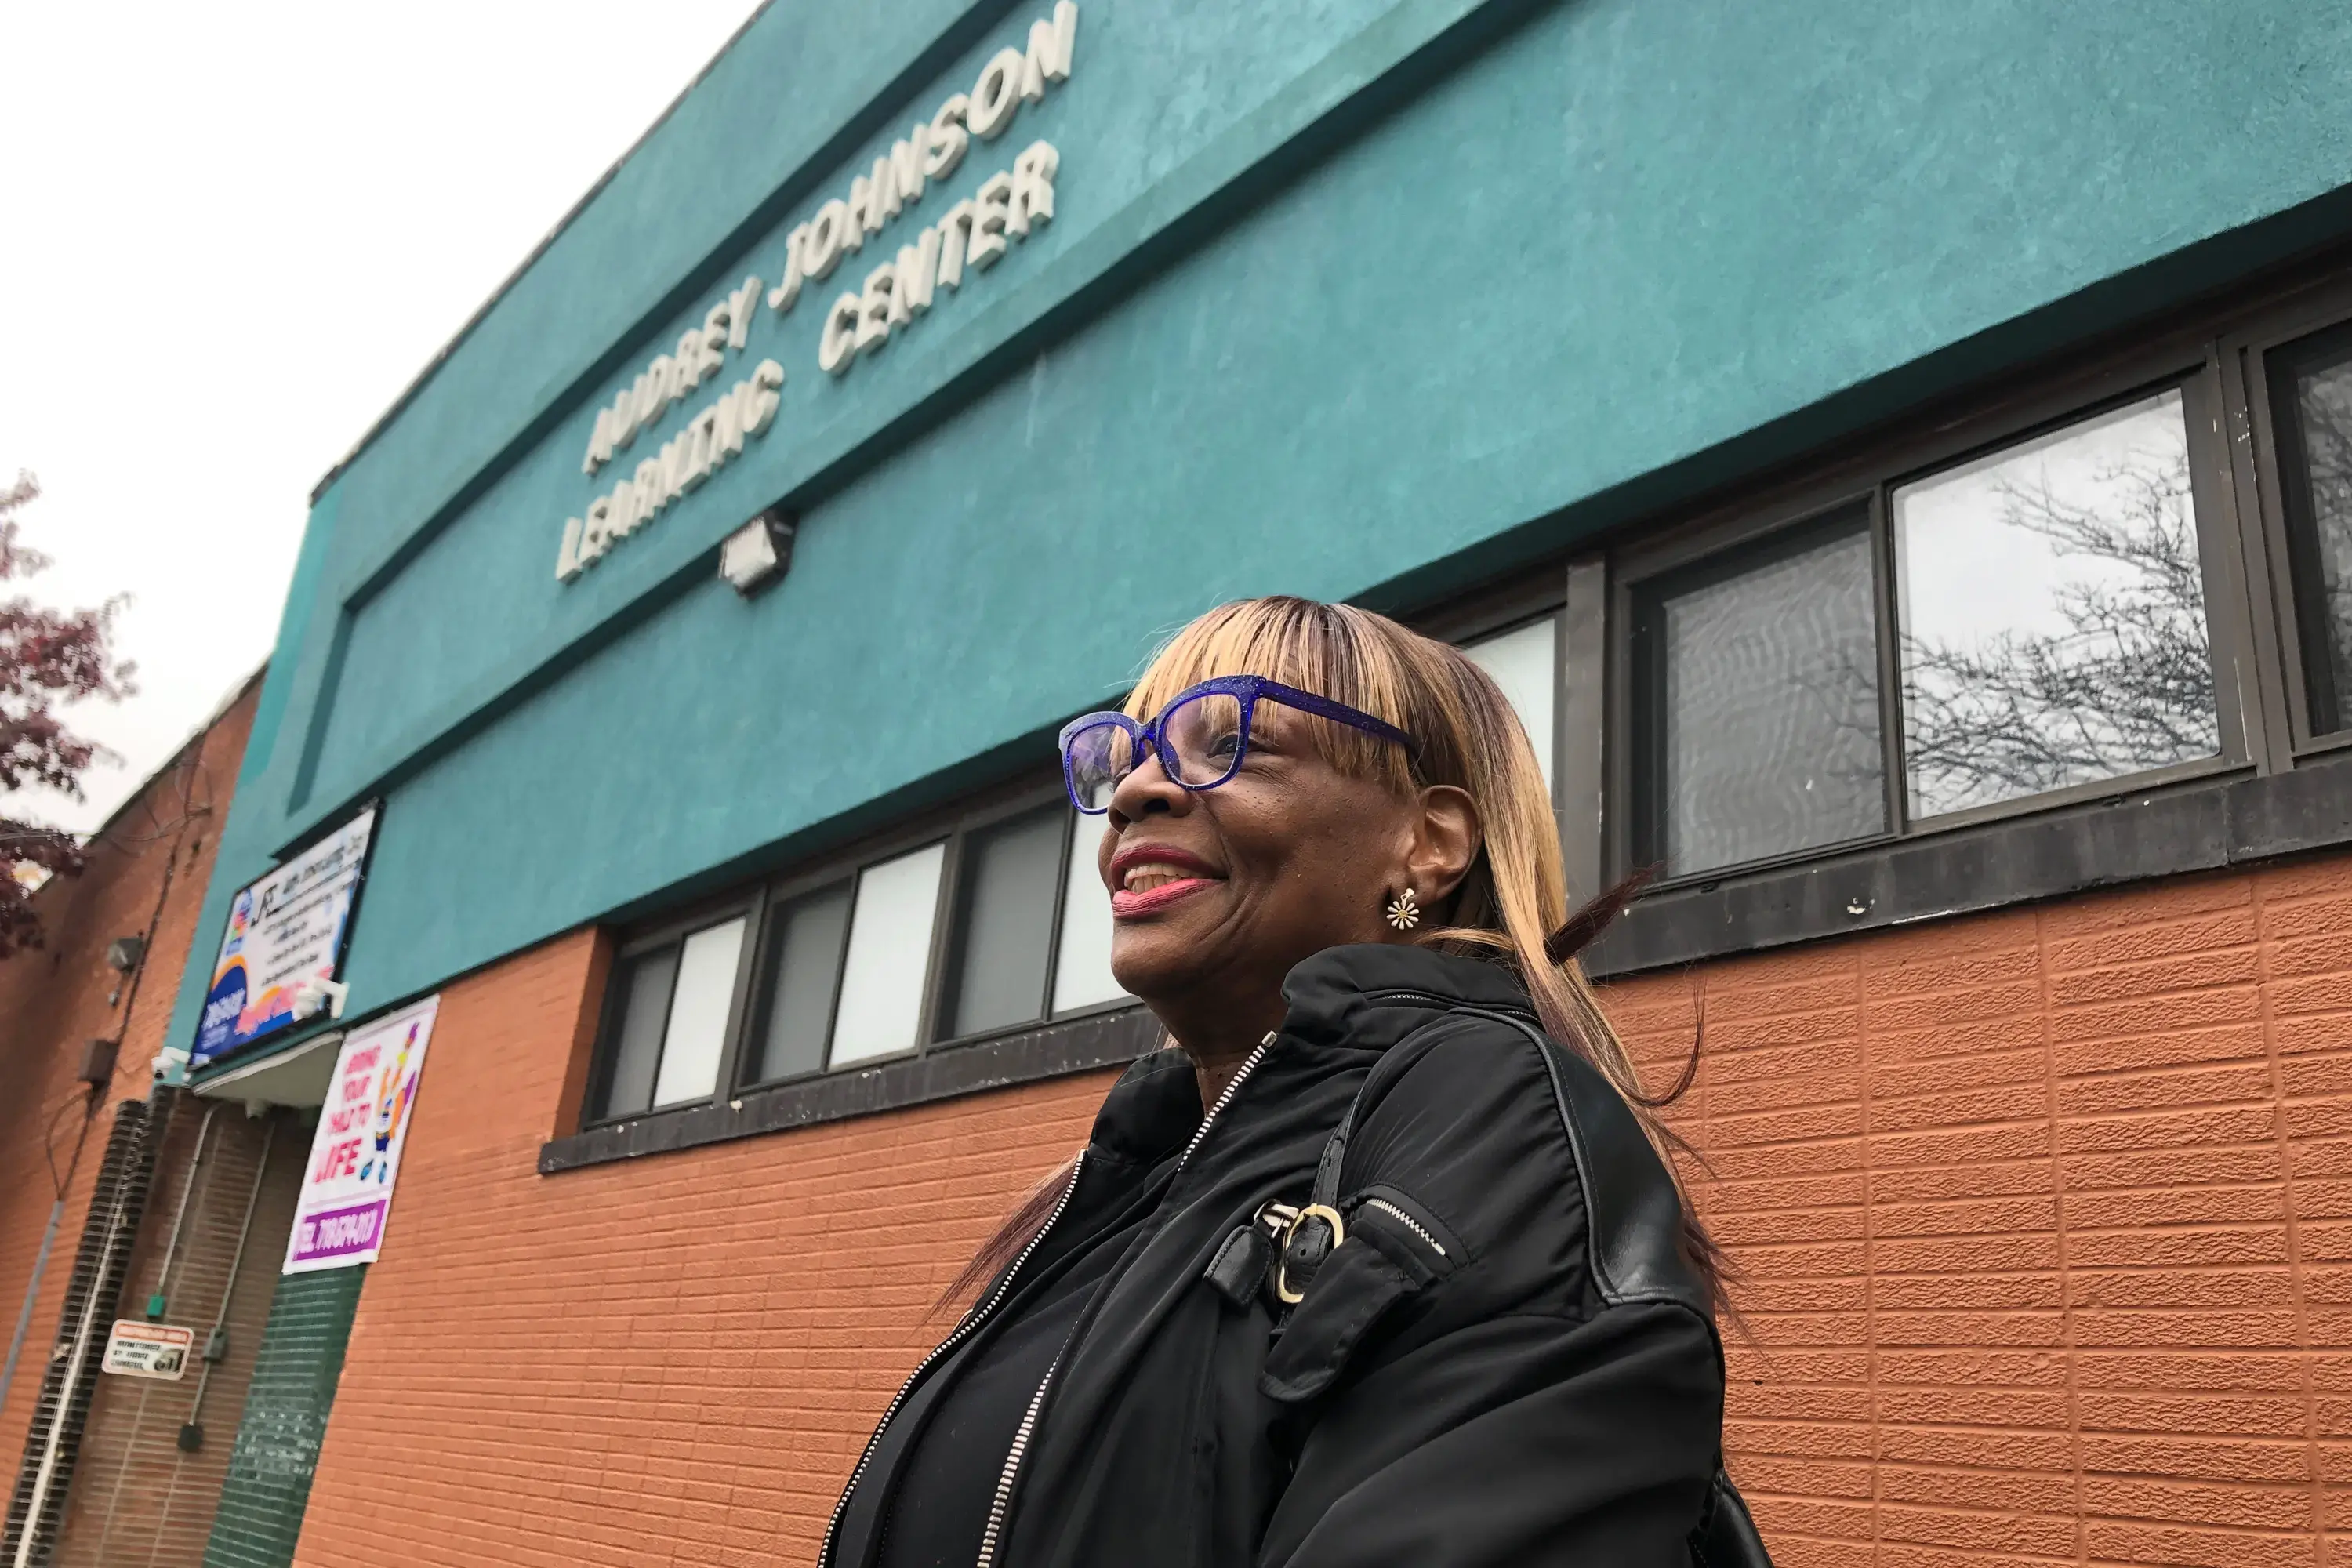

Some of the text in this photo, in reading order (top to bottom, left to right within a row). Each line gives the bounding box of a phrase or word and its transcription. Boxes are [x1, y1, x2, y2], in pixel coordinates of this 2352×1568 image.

[555, 139, 1060, 583] LEARNING CENTER
[582, 0, 1078, 476] AUDREY JOHNSON
